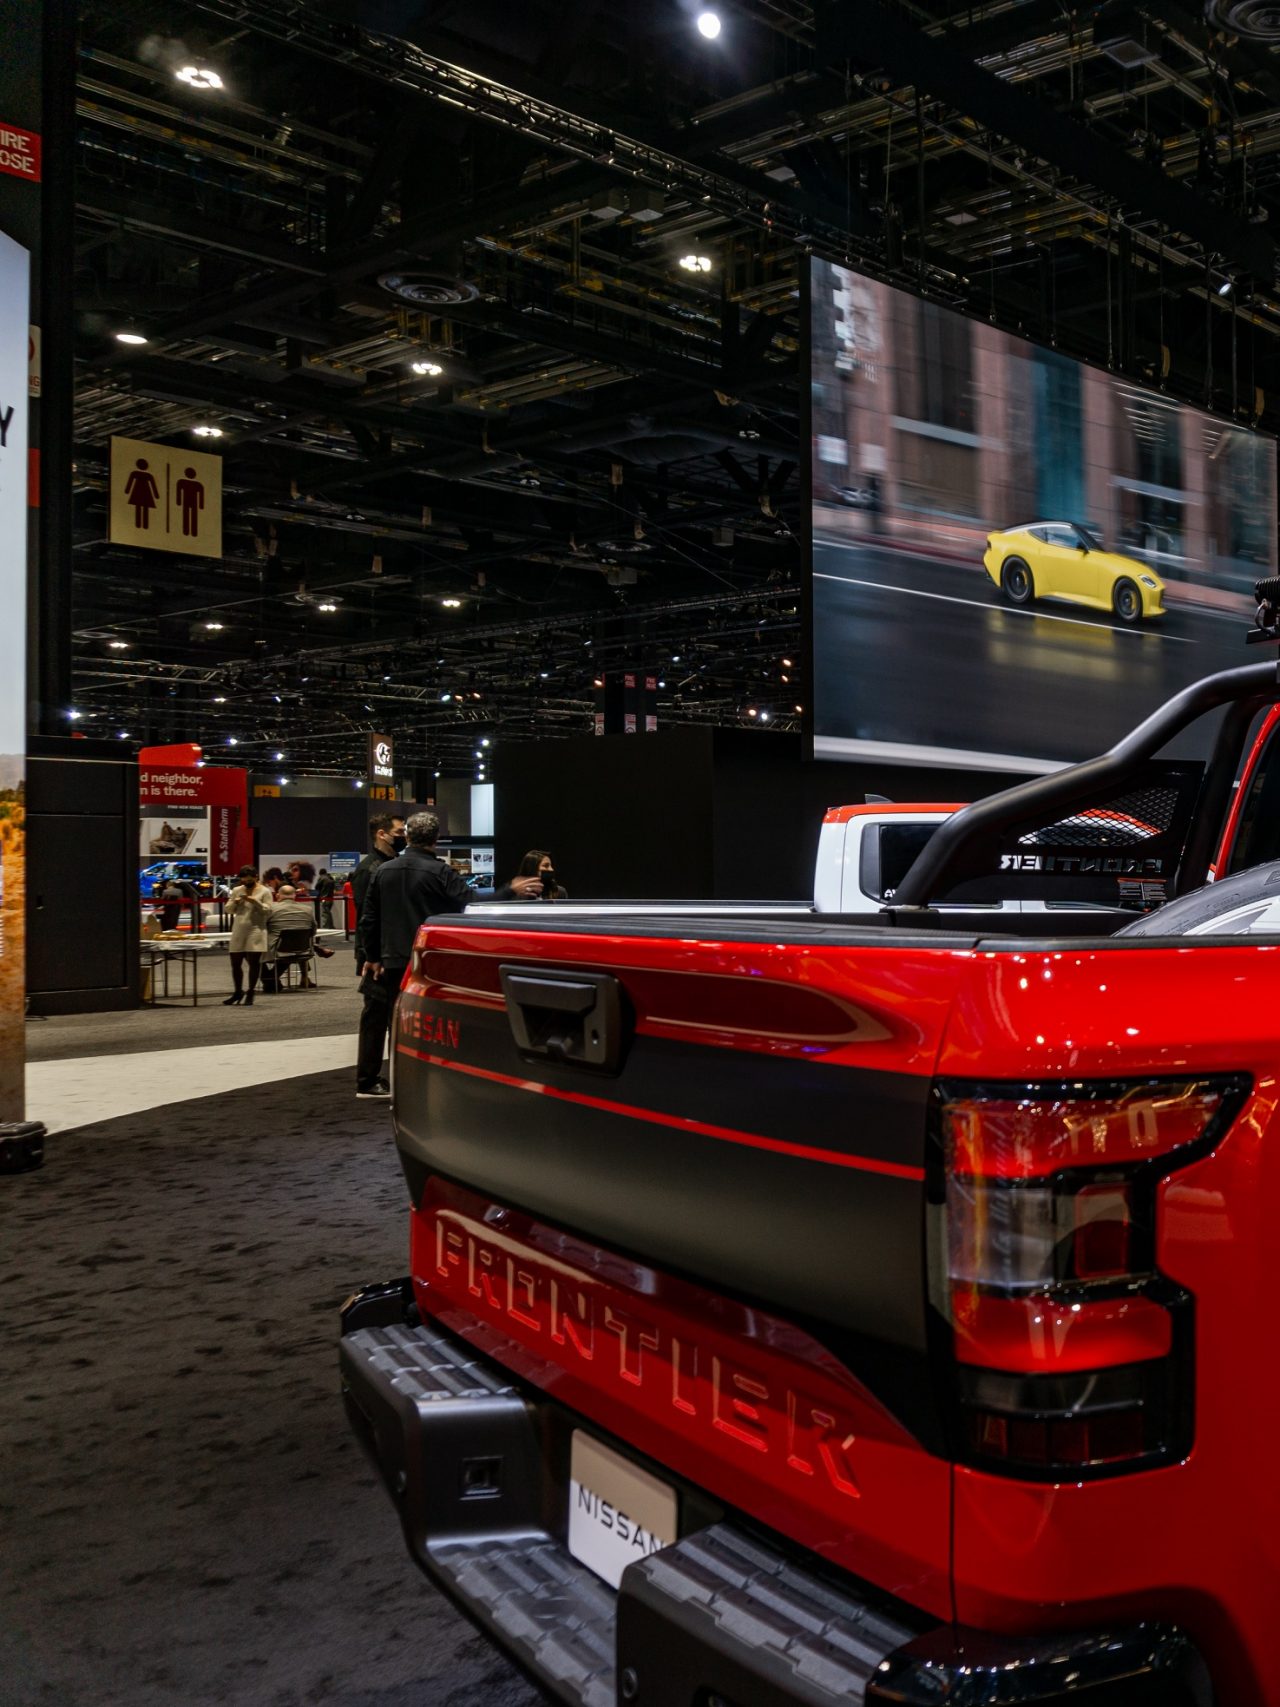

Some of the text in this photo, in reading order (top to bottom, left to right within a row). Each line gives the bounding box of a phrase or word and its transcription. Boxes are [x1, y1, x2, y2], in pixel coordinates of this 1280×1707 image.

[151, 785, 161, 796] is
[164, 786, 198, 797] there.
[400, 1008, 460, 1049] NISSAN
[434, 1217, 861, 1499] FRONTIER
[578, 1484, 666, 1555] NISSAN
